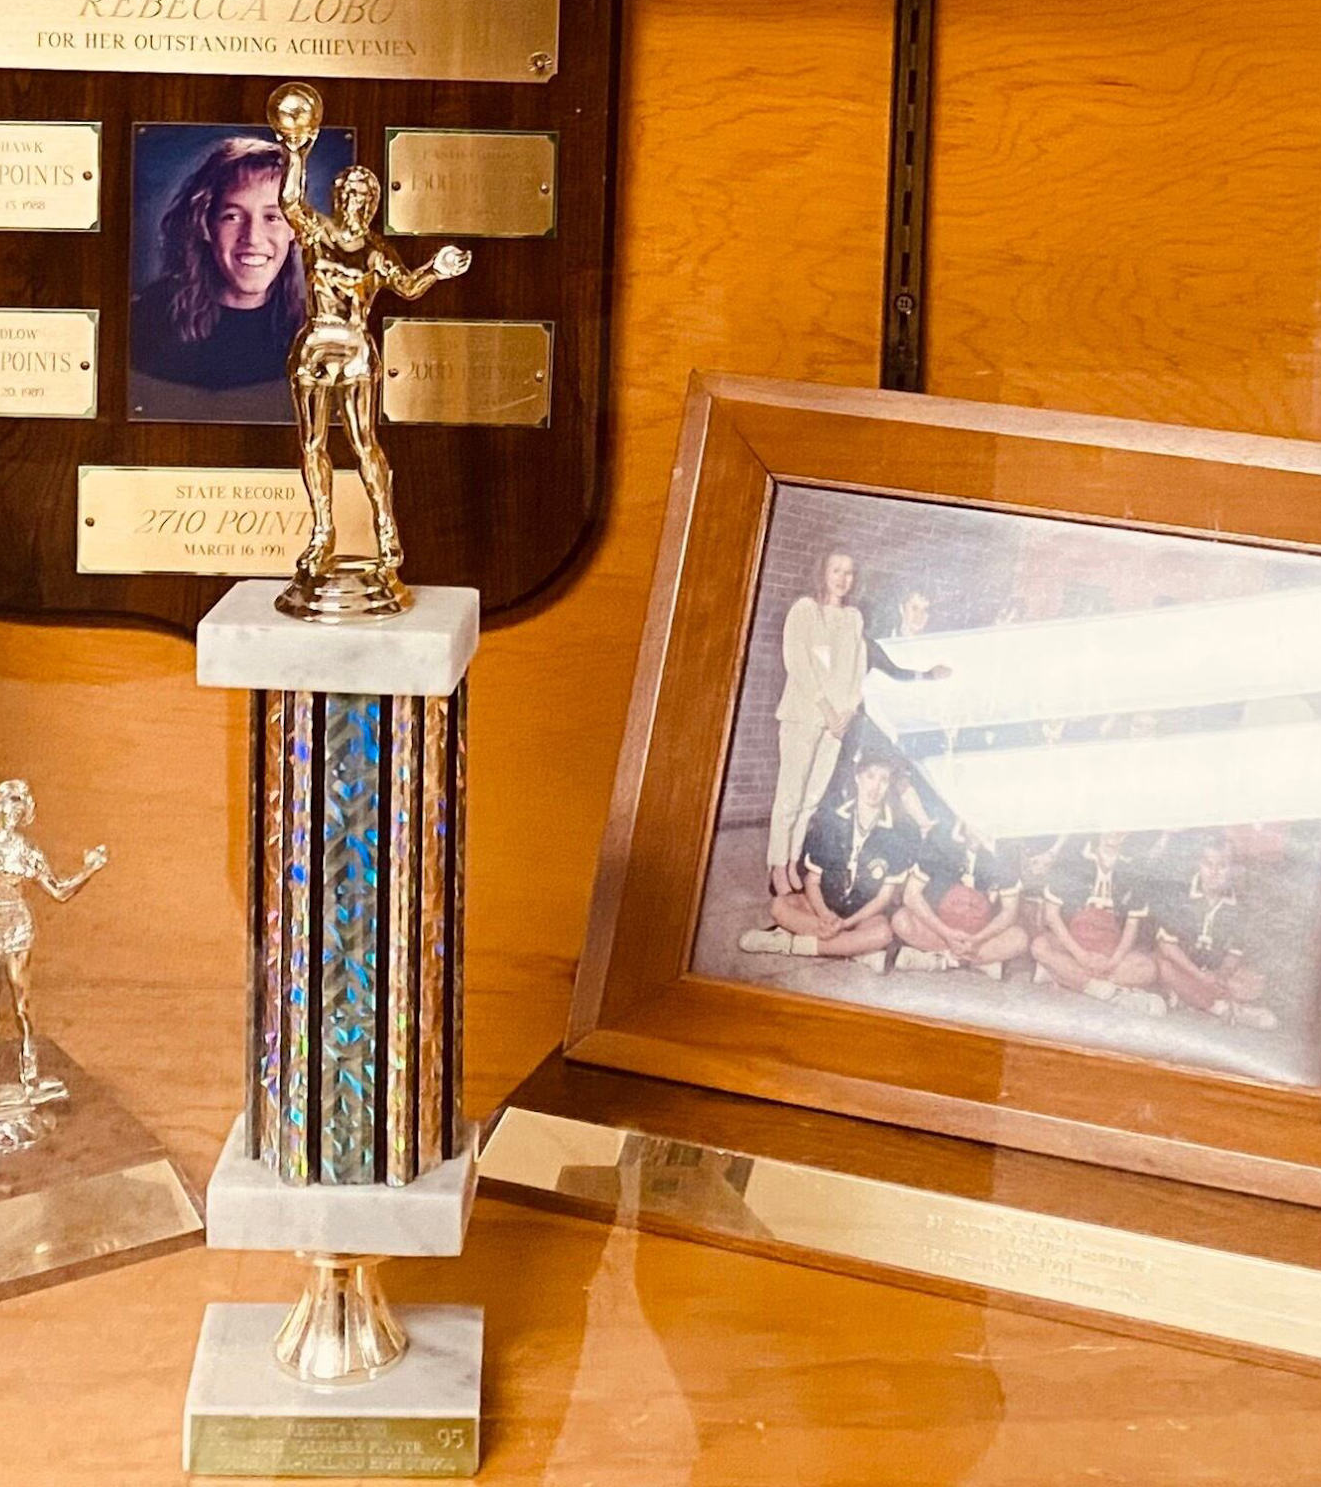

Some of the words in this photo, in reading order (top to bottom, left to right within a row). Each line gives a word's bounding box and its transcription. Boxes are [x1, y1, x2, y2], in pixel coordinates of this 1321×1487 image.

[38, 32, 75, 49] FOR
[85, 33, 127, 50] HER
[134, 34, 277, 53] OUTSTANDING
[286, 37, 418, 57] ACHIEVEMEN
[1, 351, 72, 373] POINTS
[176, 485, 225, 500] STATE
[232, 486, 296, 501] RECORD
[136, 509, 207, 535] 2710
[217, 511, 315, 536] POINT
[184, 543, 235, 556] MARCH
[240, 543, 254, 556] 16
[260, 544, 286, 557] 1991
[437, 1427, 464, 1449] 95
